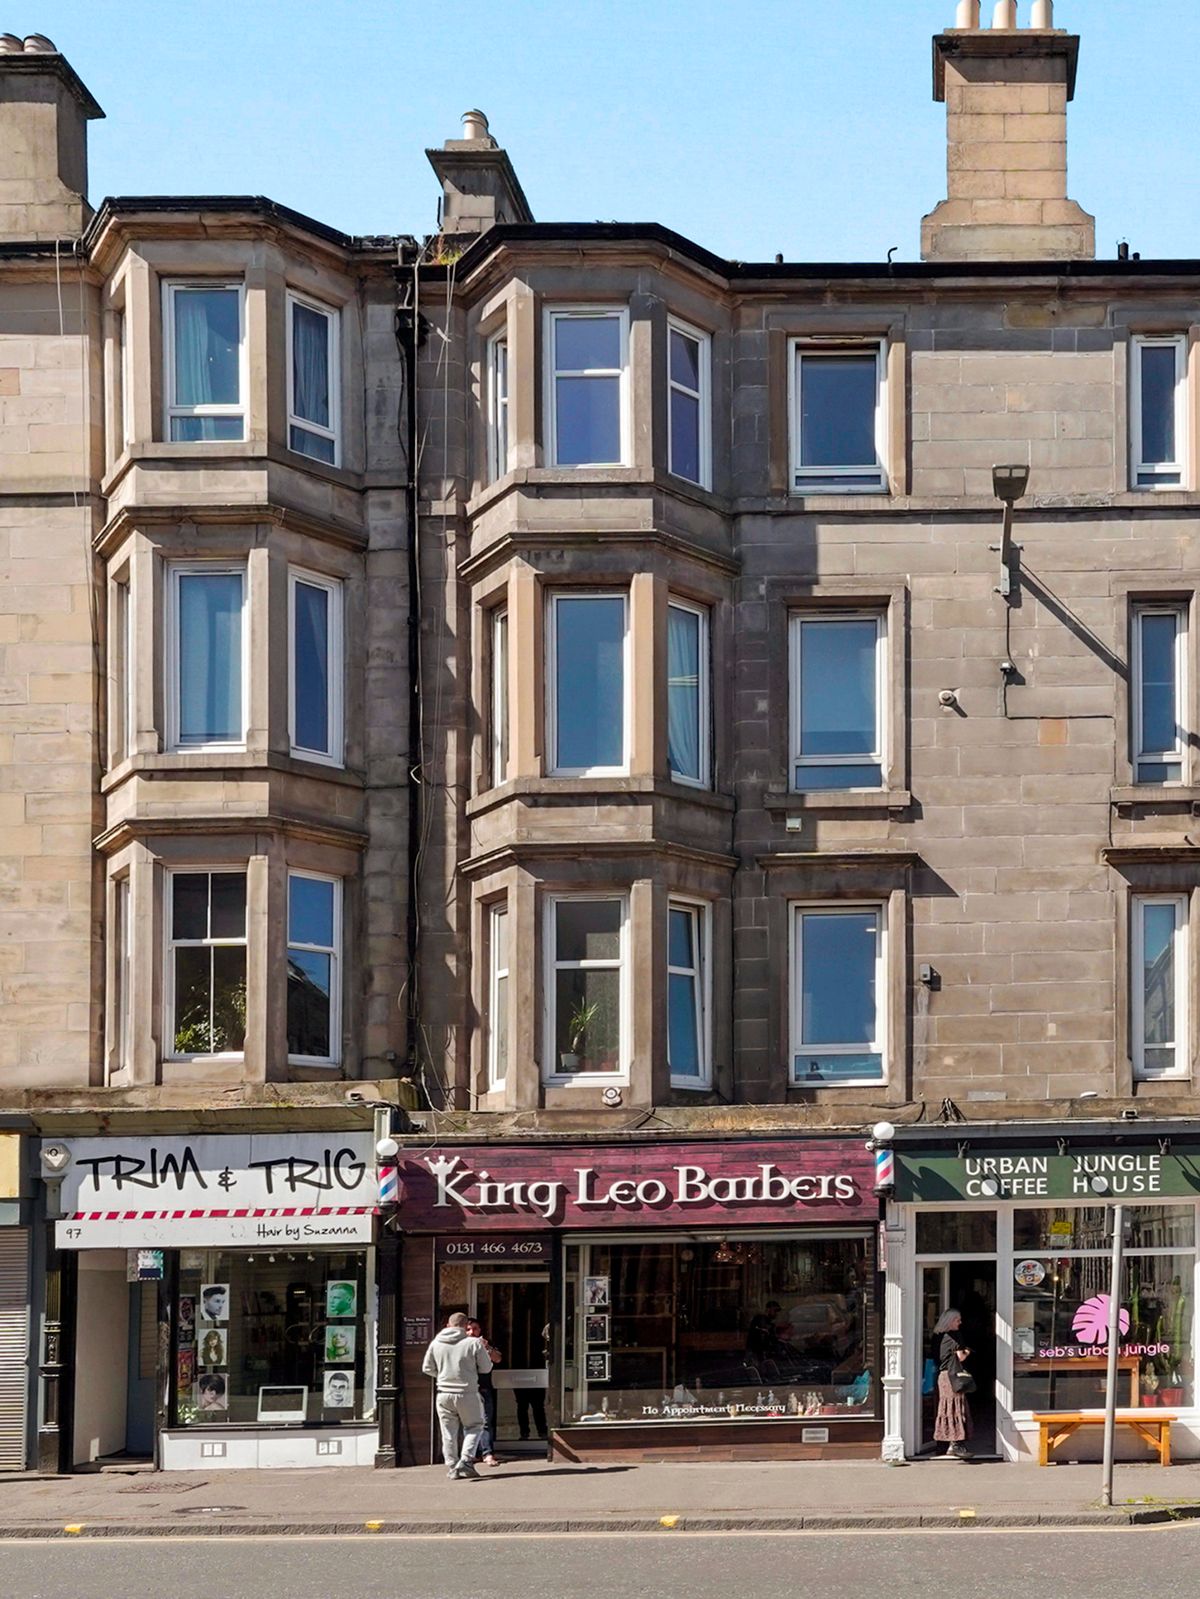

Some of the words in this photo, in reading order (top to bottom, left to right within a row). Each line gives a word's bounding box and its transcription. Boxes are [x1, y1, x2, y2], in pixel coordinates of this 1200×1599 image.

[75, 1146, 208, 1192] TRIM
[217, 1166, 237, 1192] &
[248, 1148, 366, 1194] TRIG
[965, 1156, 1048, 1175] URBAN
[1073, 1154, 1161, 1173] JUNGLE
[431, 1166, 562, 1218] King
[573, 1168, 666, 1207] Leo
[673, 1164, 855, 1204] Barbers
[966, 1177, 1048, 1196] COFFEE
[1073, 1175, 1161, 1193] HOUSE
[66, 1228, 82, 1239] 97
[257, 1224, 283, 1238] Hair
[284, 1225, 300, 1240] by
[303, 1224, 358, 1238] Suzanna
[446, 1243, 475, 1255] 0131
[481, 1242, 506, 1255] 466
[511, 1241, 543, 1254] 4673
[1039, 1346, 1075, 1358] seb's
[1124, 1343, 1170, 1357] jungle
[642, 1406, 659, 1415] No
[662, 1404, 731, 1416] Appointment
[735, 1403, 786, 1413] Necessary
